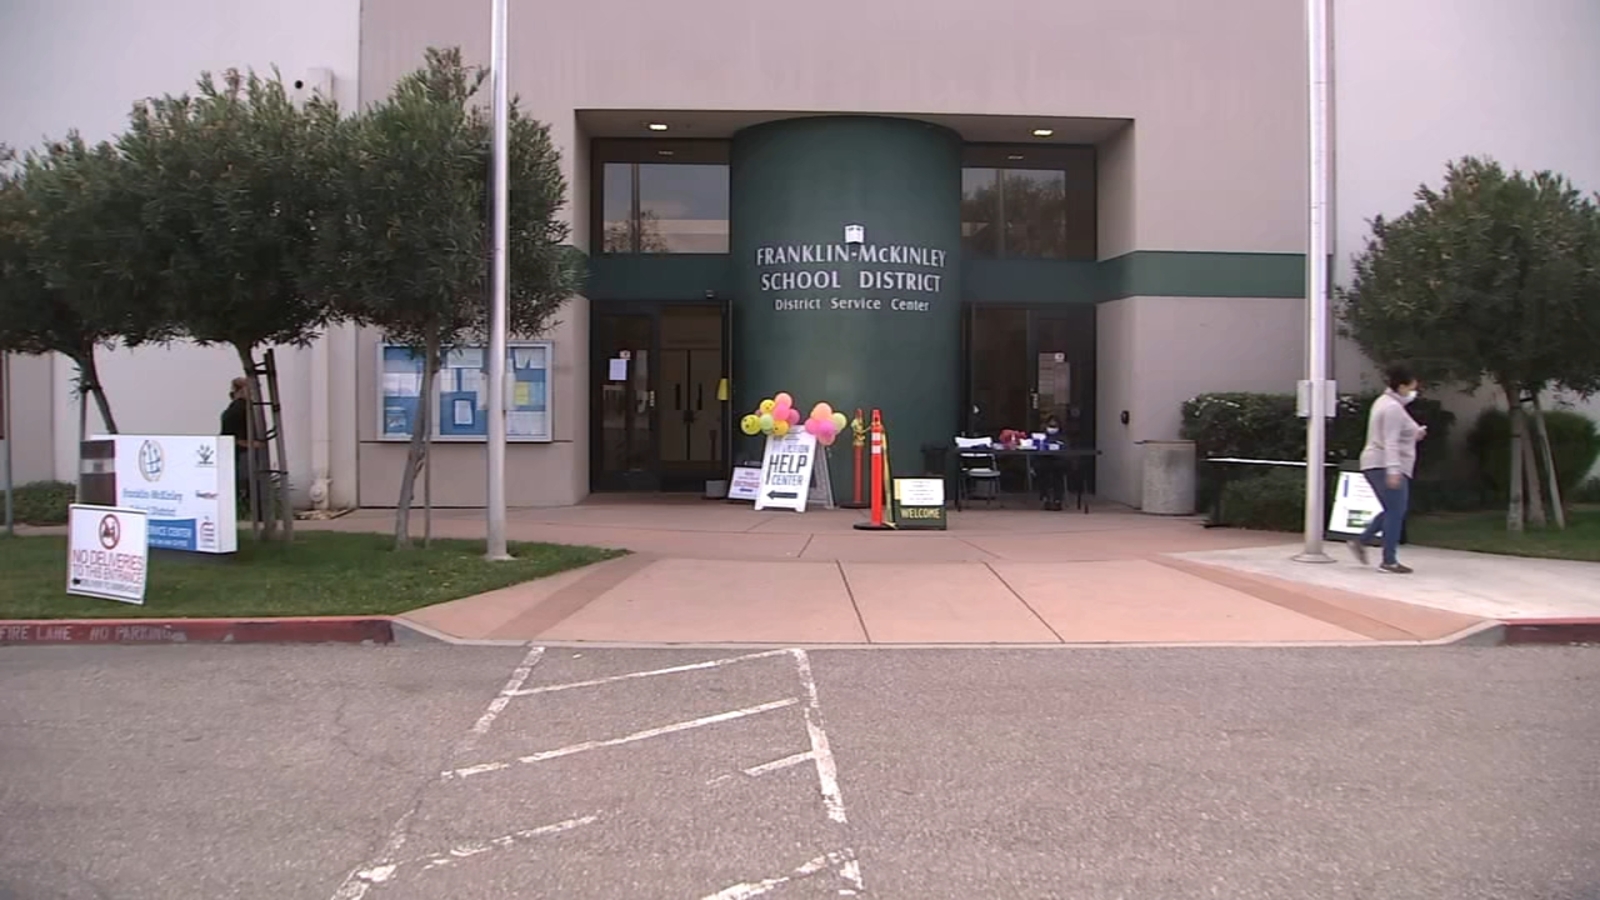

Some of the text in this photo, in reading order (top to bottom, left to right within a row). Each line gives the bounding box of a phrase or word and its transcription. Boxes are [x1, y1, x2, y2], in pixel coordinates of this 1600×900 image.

[761, 270, 941, 292] SCHOOL DISTRICT
[775, 297, 929, 311] District Service Center
[765, 454, 808, 485] HELP
[771, 475, 804, 486] CENTER
[901, 508, 941, 519] WELCOME
[73, 549, 143, 571] NO DELIVERIES
[103, 567, 143, 585] ENTRANCE
[0, 624, 173, 640] FIRE LANE NO PARKING
